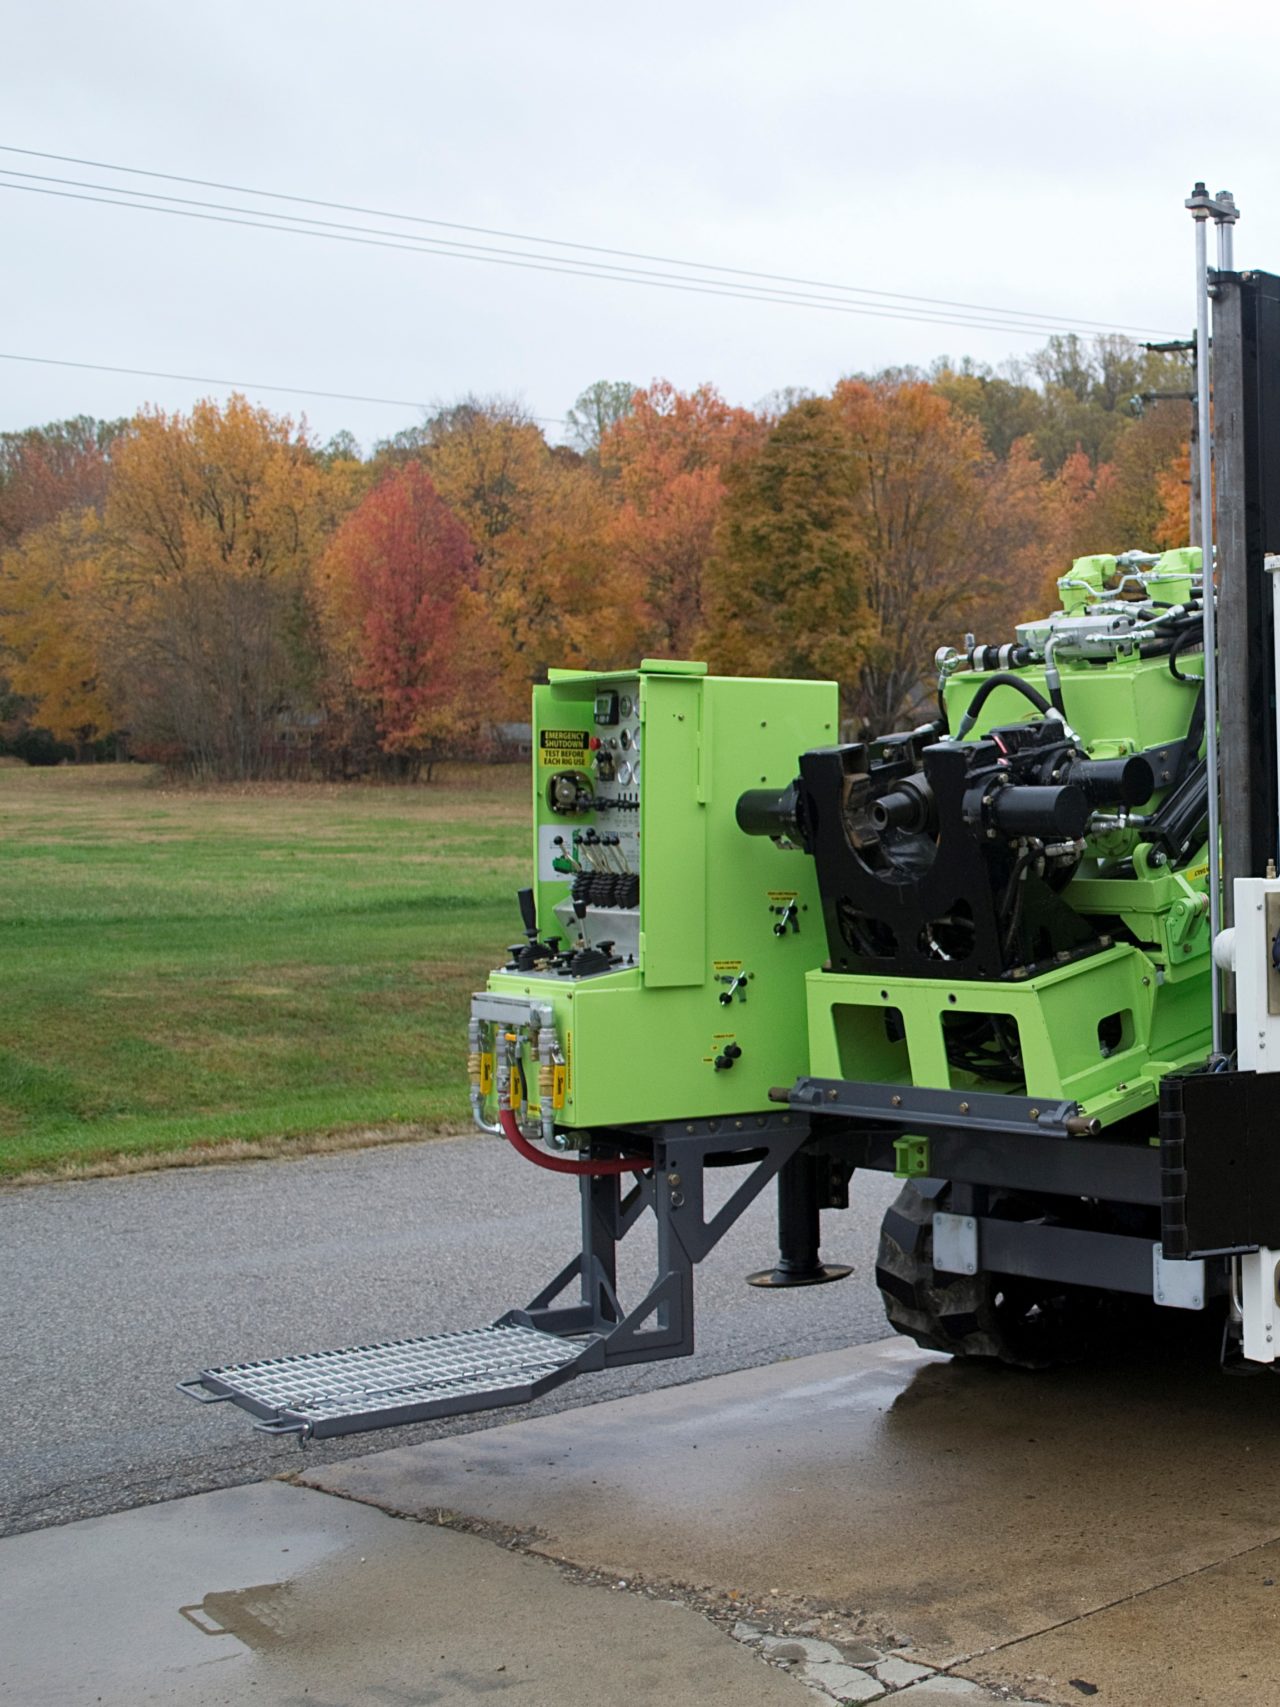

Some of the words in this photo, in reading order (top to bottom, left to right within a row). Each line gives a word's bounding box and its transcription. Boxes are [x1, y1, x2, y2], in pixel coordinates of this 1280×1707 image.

[544, 731, 585, 739] EMERGENCY
[544, 740, 584, 748] SHUTDOWN
[544, 758, 560, 766] EACH
[573, 758, 585, 766] USE
